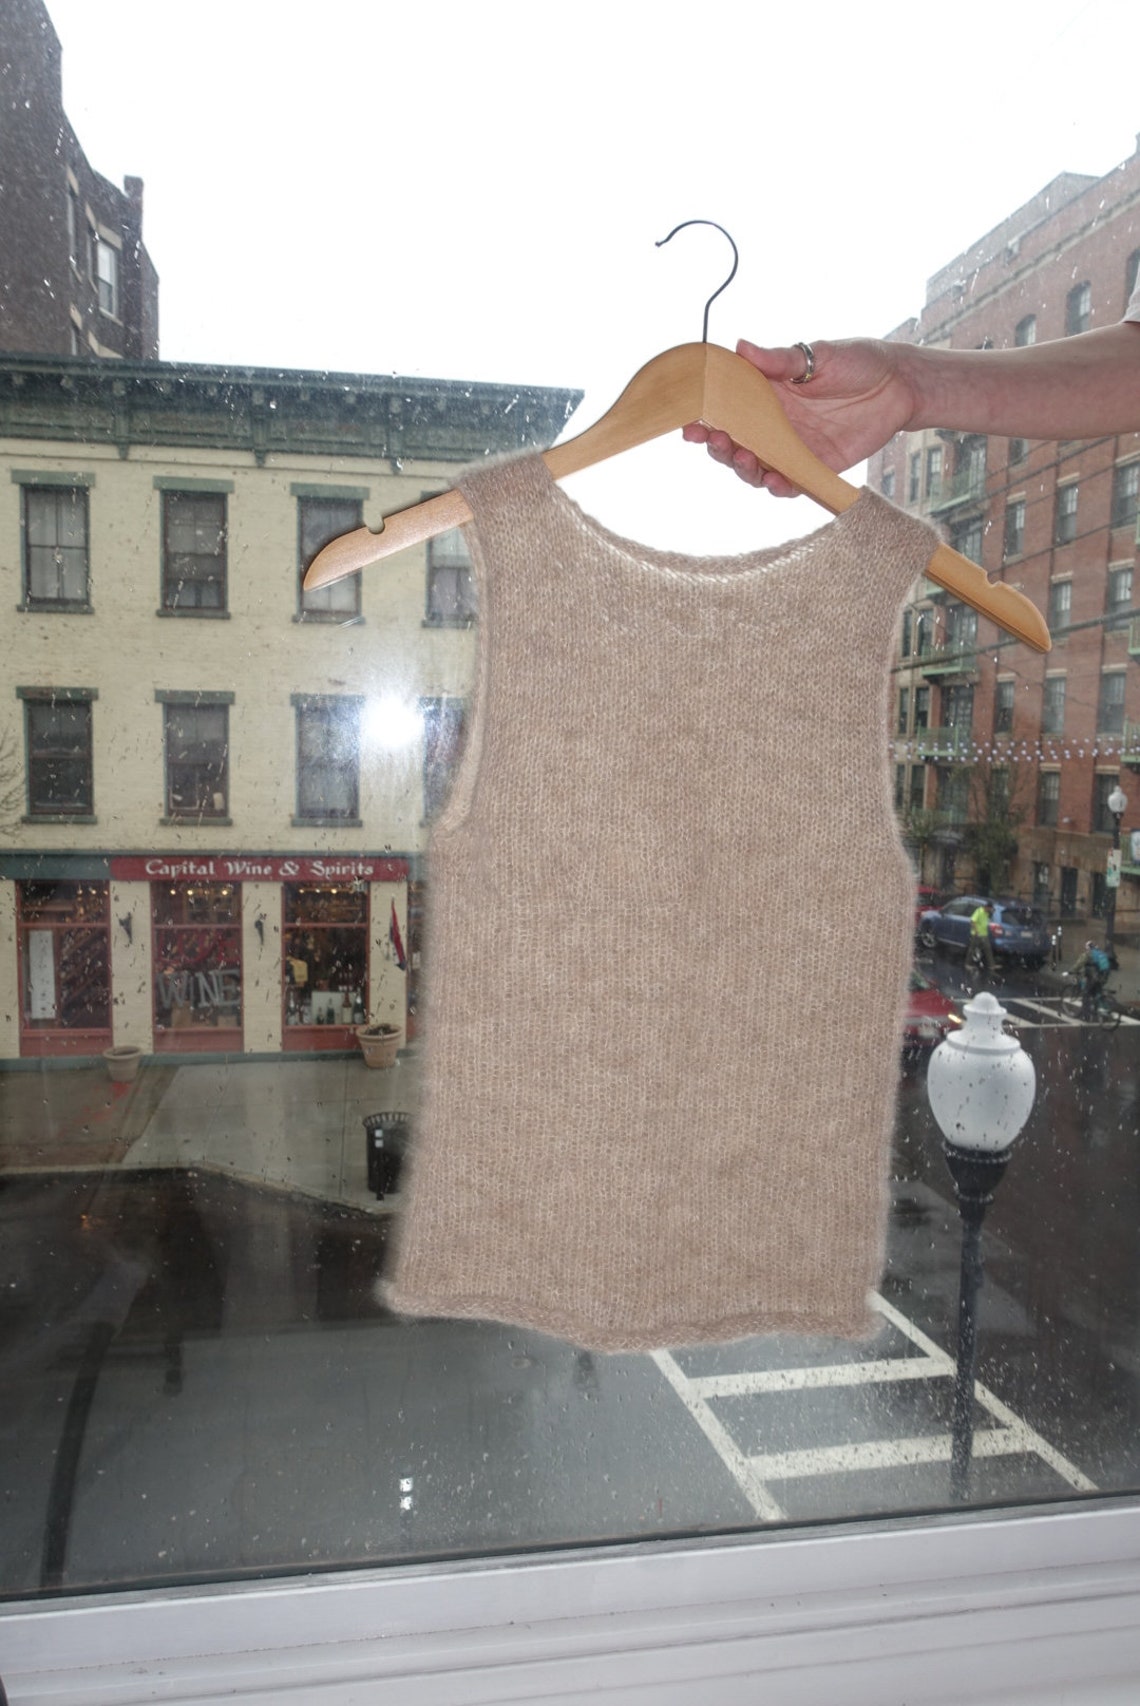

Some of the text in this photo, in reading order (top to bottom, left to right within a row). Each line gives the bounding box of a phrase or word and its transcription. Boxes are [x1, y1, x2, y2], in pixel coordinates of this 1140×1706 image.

[146, 860, 374, 878] Capital Wine & Spirits
[157, 968, 241, 1010] WINE
